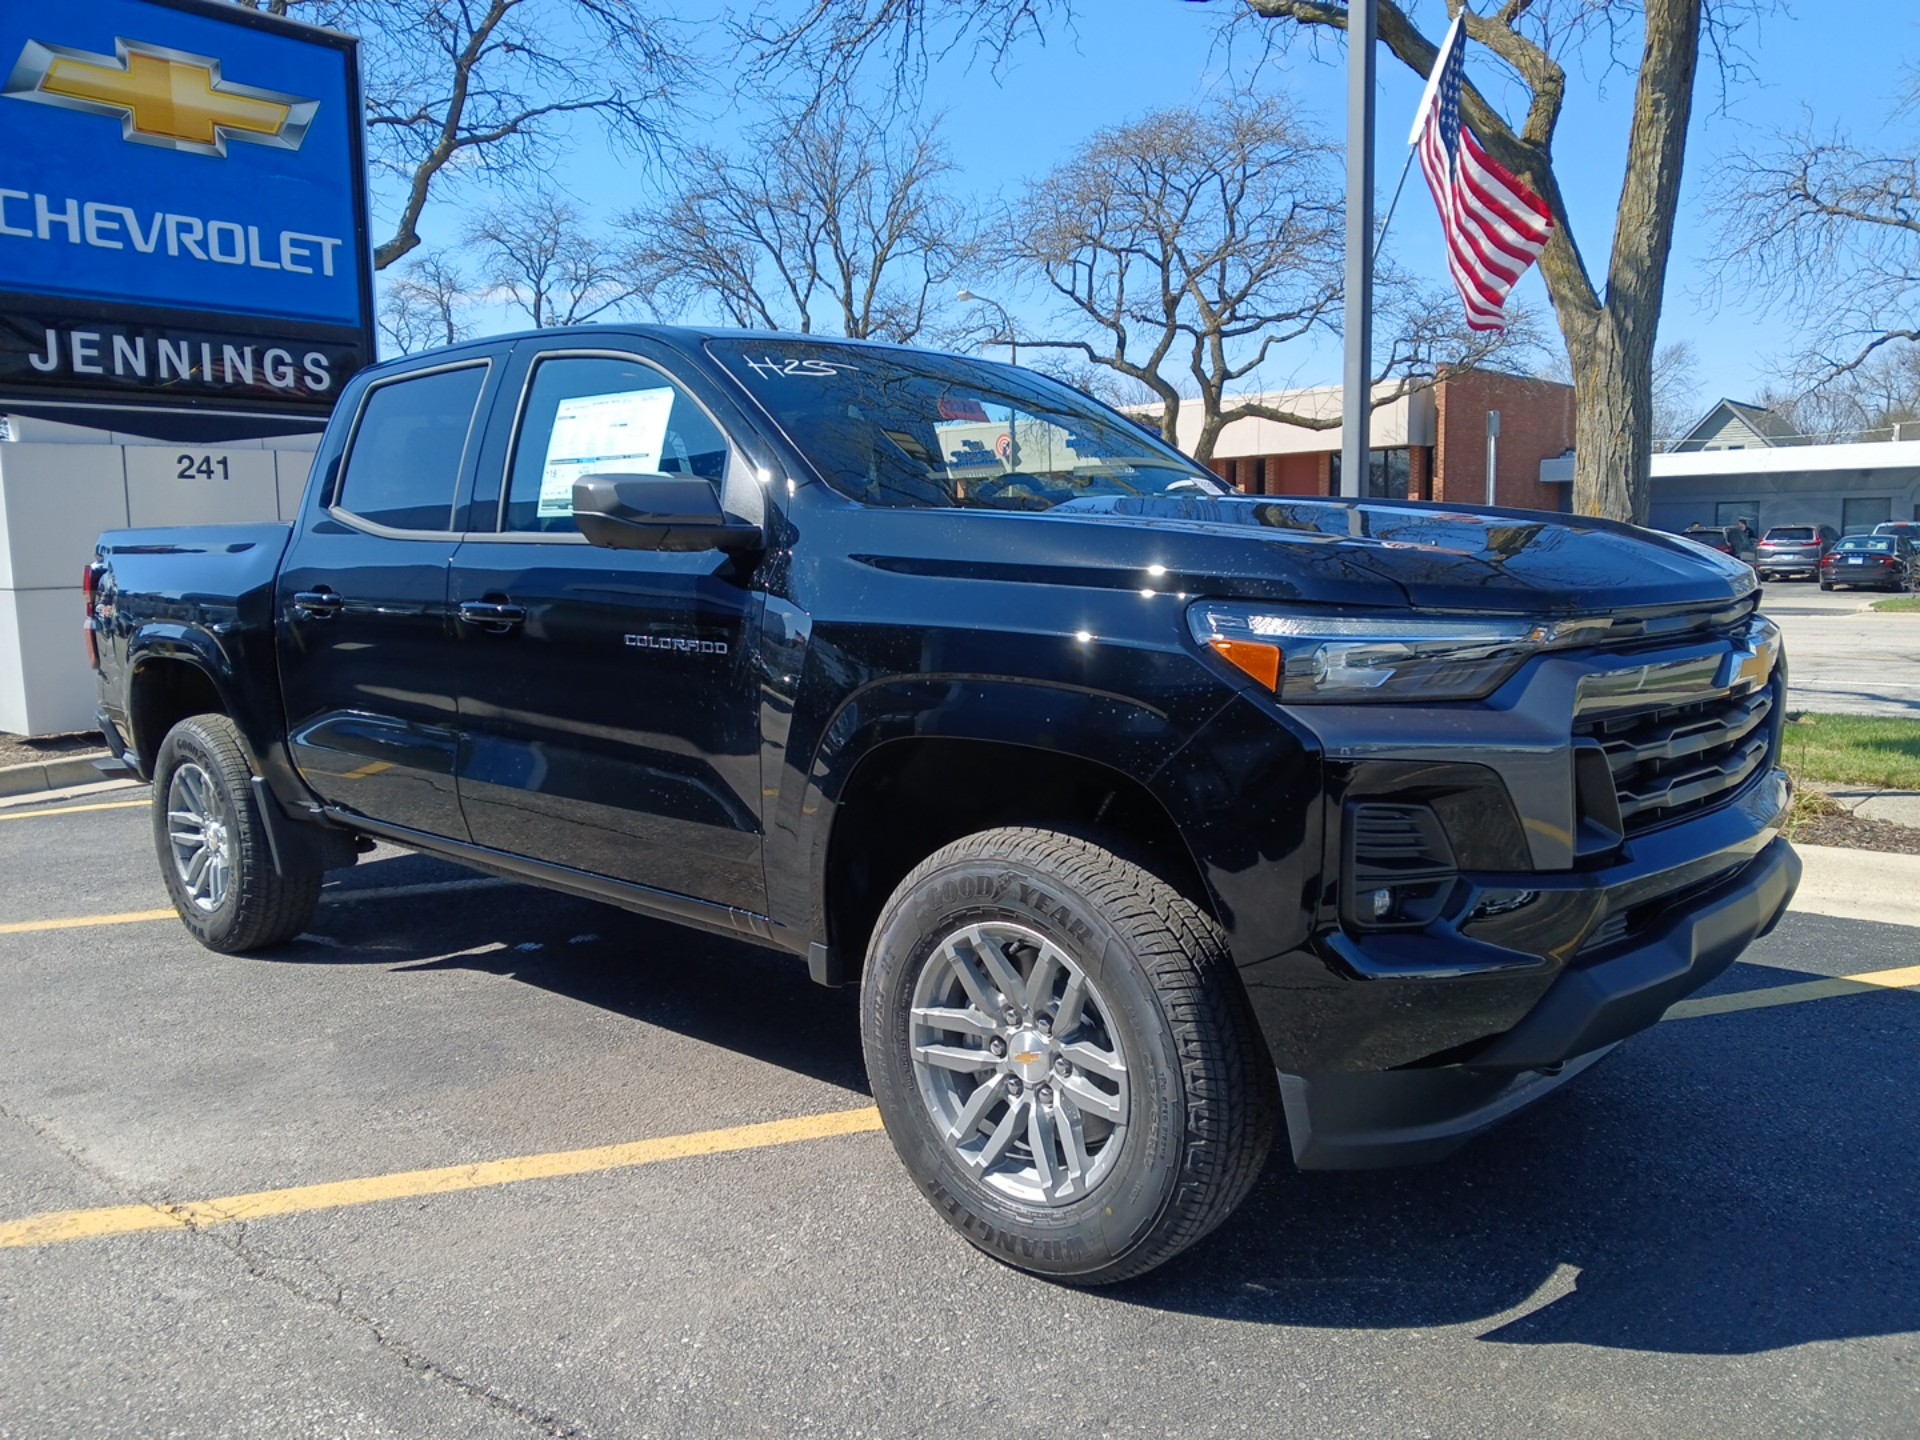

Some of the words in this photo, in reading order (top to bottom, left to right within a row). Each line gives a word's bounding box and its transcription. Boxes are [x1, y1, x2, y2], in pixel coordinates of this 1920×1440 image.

[0, 188, 342, 276] CHEVROLET
[29, 328, 331, 391] JENNINGS
[176, 455, 230, 481] 241
[624, 634, 728, 654] COLORADO
[927, 1178, 1092, 1262] WRANGLER
